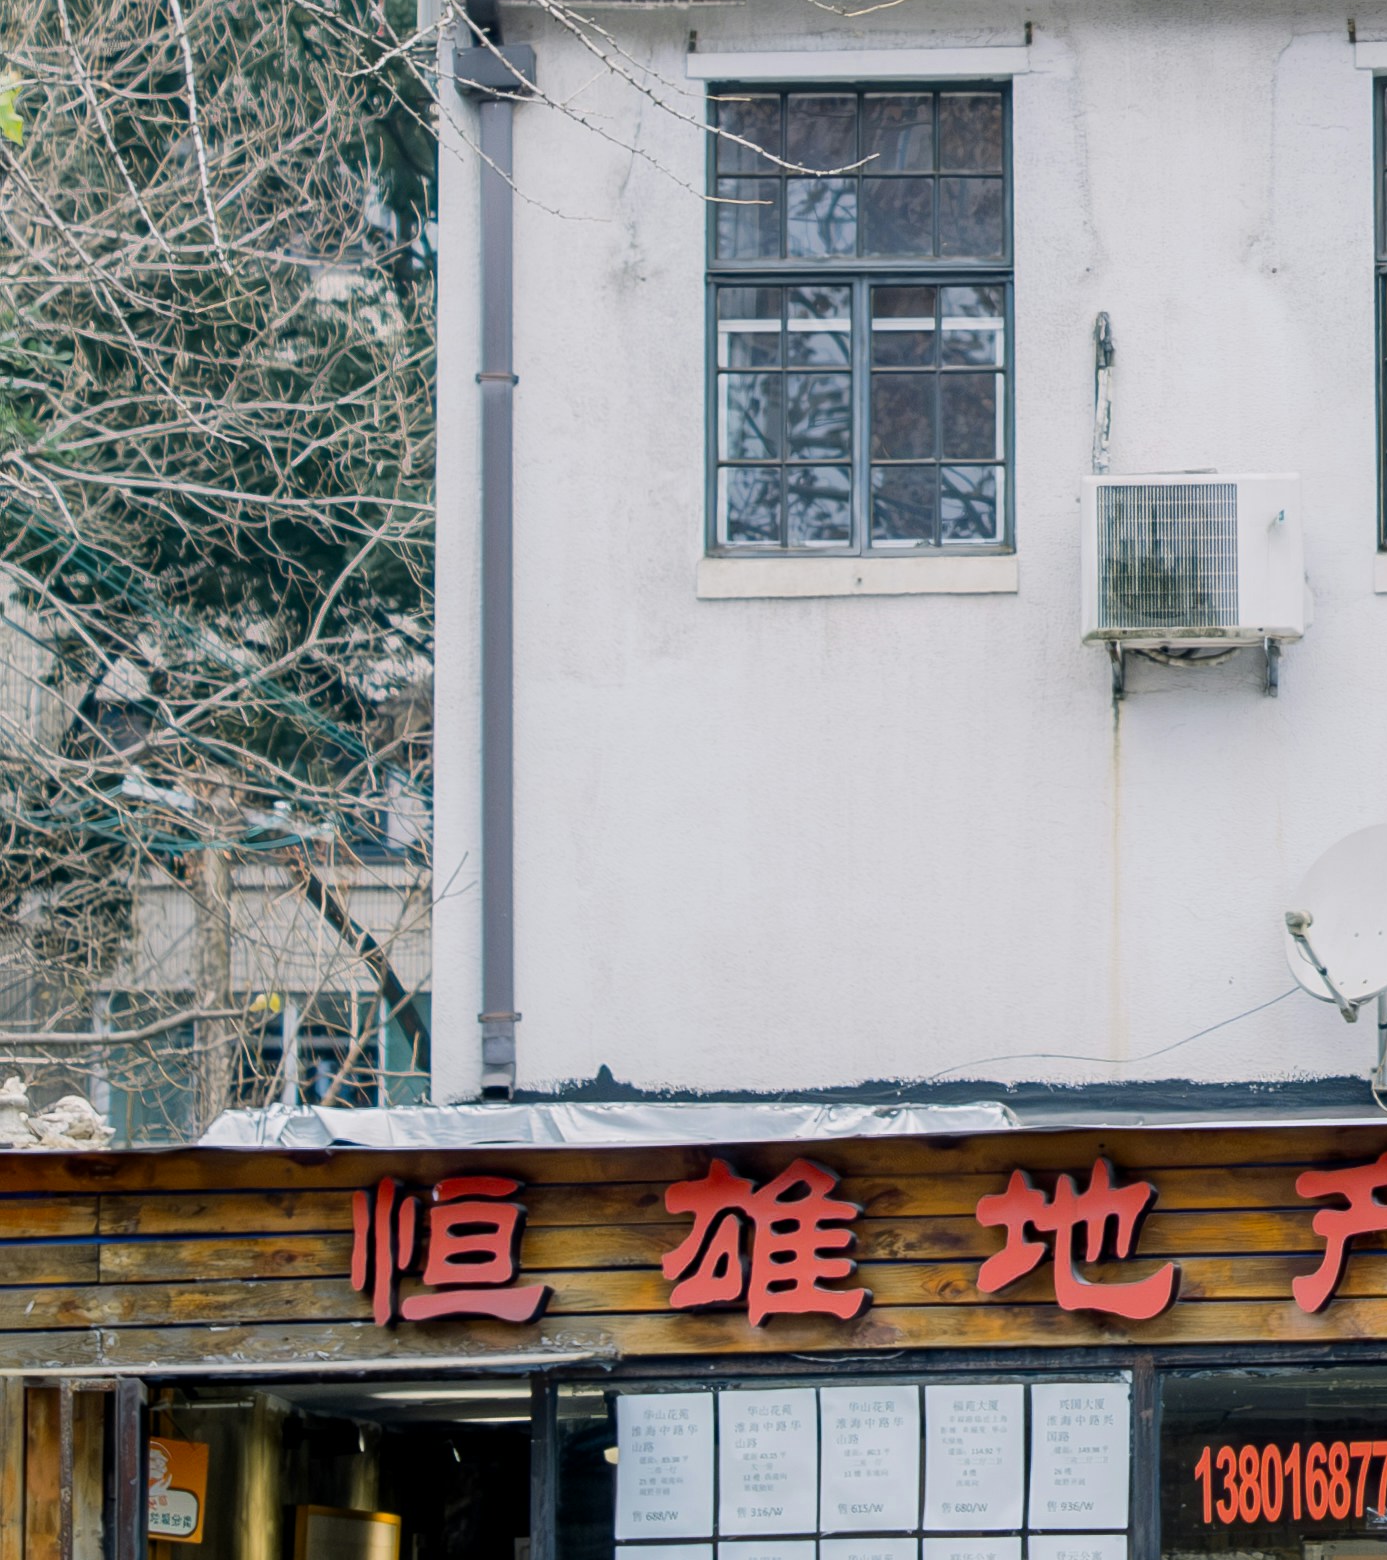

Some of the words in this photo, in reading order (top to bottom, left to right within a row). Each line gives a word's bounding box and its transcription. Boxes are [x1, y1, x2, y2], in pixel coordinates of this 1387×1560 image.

[1059, 1398, 1105, 1410] 兴国大厦
[1047, 1431, 1069, 1442] 国路
[851, 1503, 884, 1513] 615/W
[955, 1503, 988, 1513] 680/W
[1060, 1501, 1095, 1512] 936/W
[645, 1511, 678, 1521] 688/W
[751, 1507, 783, 1518] 316/W
